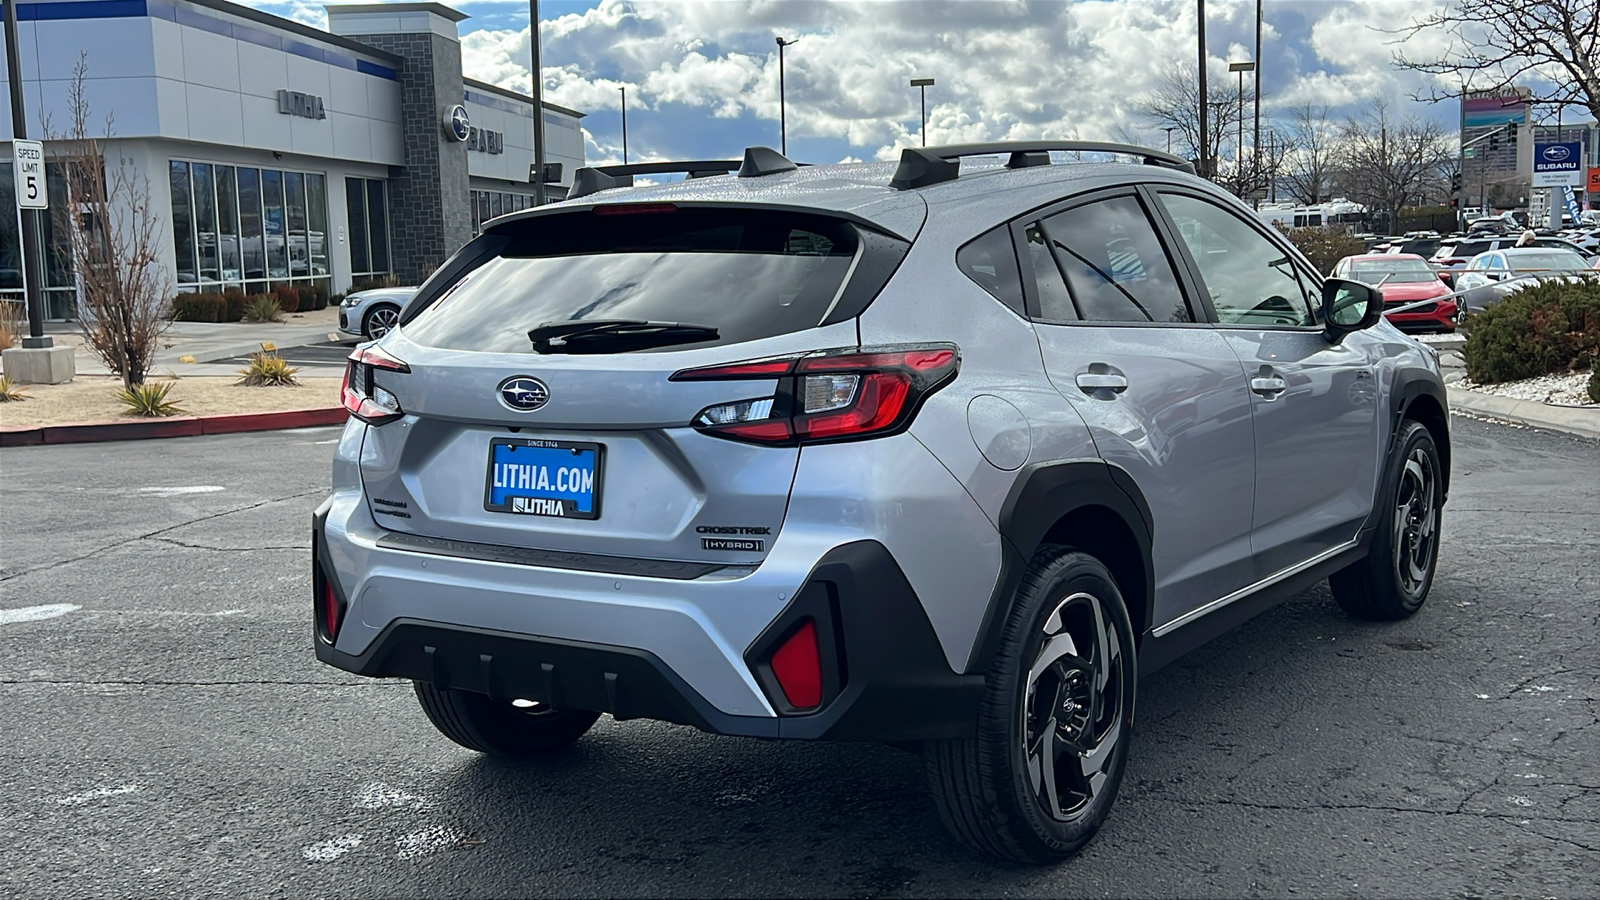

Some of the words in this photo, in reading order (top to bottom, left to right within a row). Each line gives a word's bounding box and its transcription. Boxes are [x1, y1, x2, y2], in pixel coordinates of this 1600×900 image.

[278, 89, 326, 120] LITHIA
[467, 127, 503, 154] BARU
[18, 148, 40, 160] SPEED
[22, 162, 38, 173] LIMIT
[1537, 162, 1577, 170] SUBARU
[27, 176, 38, 199] 5
[493, 462, 594, 493] LITHIA.COM
[524, 498, 564, 516] LITHIA
[696, 526, 771, 535] CROSSTREK
[710, 541, 754, 549] HYBRID
